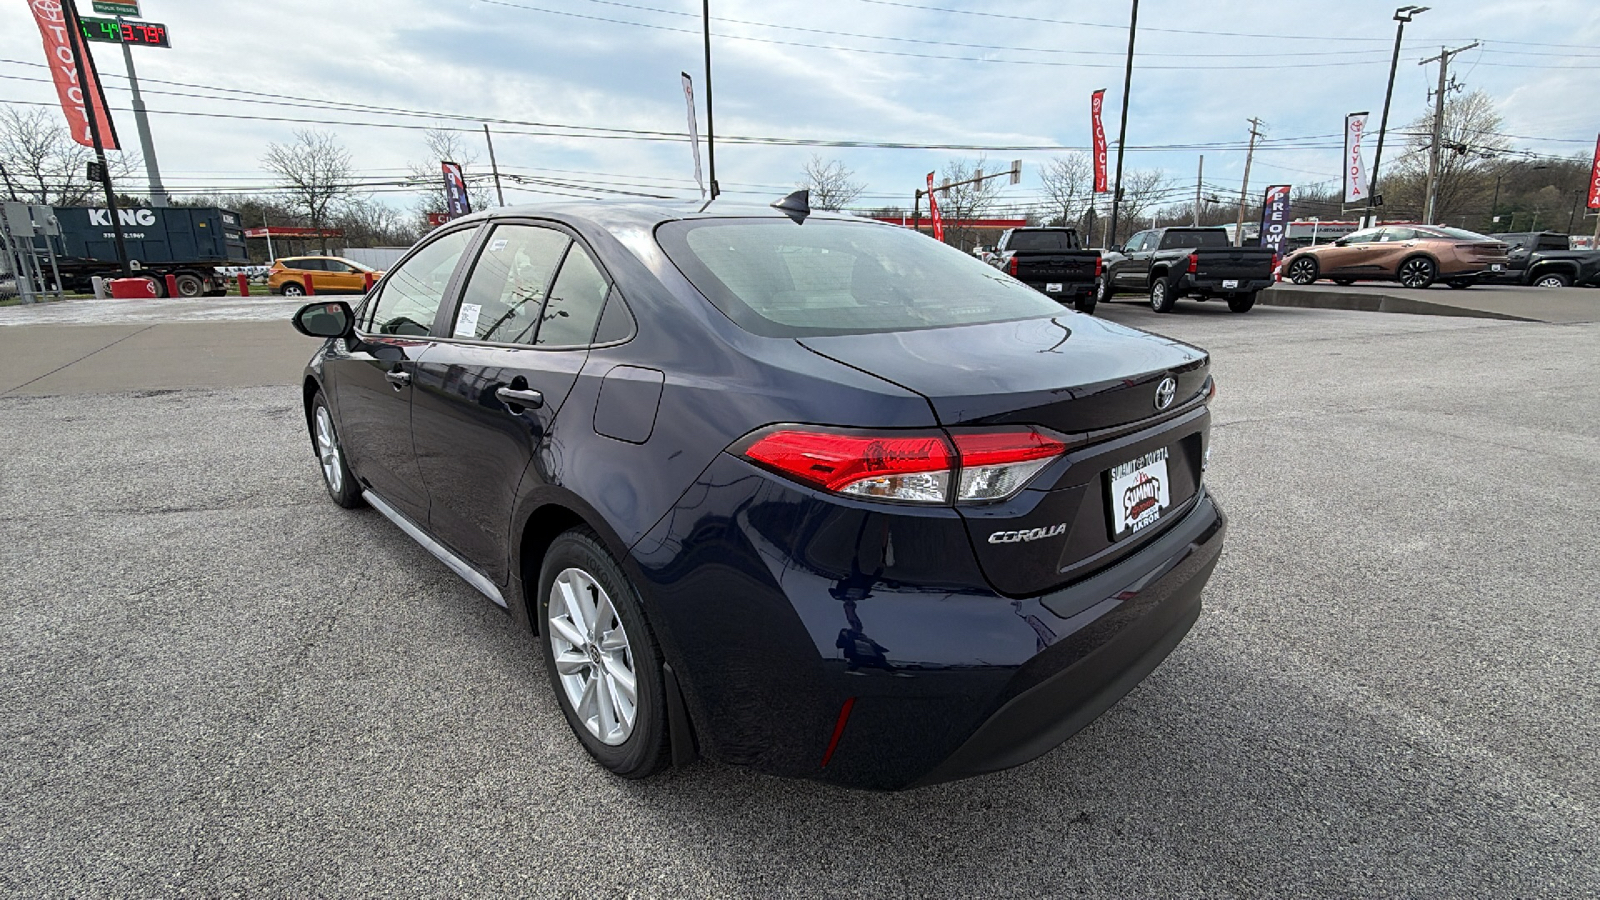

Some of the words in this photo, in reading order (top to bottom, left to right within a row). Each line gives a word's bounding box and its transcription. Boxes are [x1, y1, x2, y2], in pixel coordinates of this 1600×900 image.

[1350, 134, 1360, 195] TOYOTA
[1271, 192, 1284, 221] PRE
[1144, 446, 1169, 467] TOYOTA
[1124, 478, 1160, 520] SUMMIT
[988, 523, 1067, 544] COROLLA
[1133, 511, 1160, 534] AKRON
